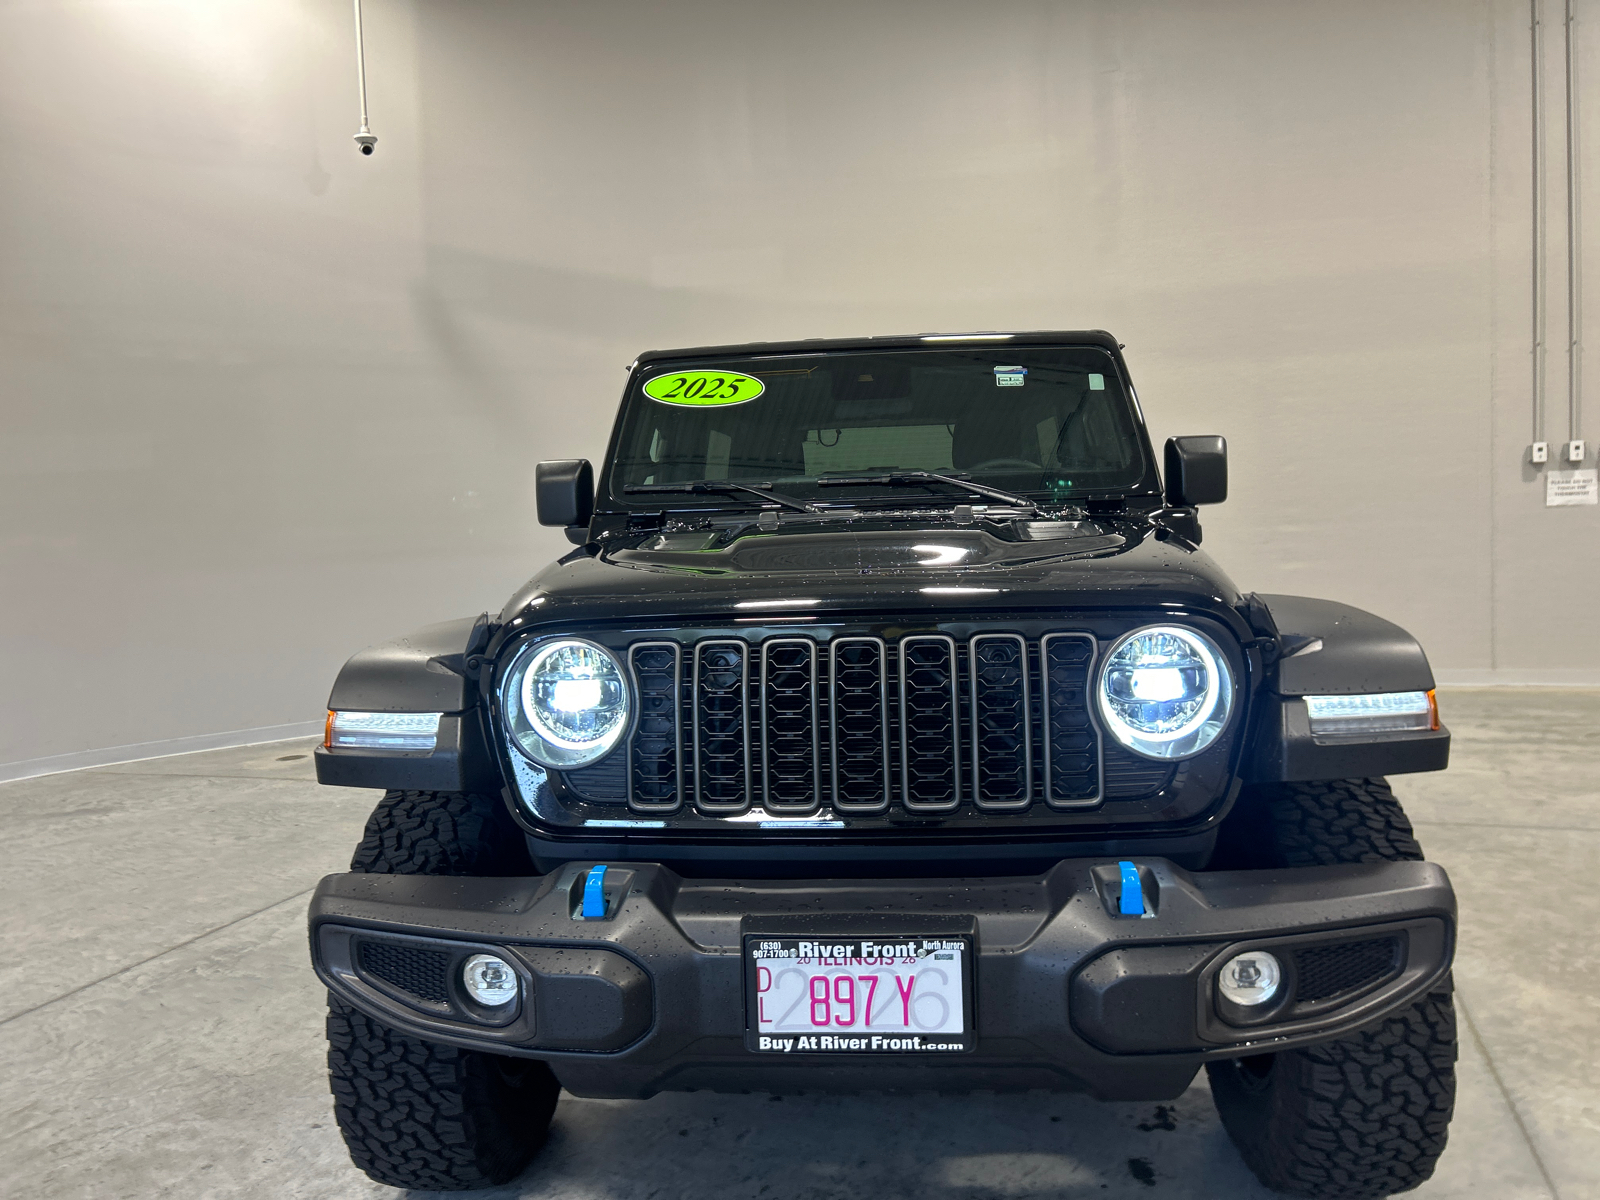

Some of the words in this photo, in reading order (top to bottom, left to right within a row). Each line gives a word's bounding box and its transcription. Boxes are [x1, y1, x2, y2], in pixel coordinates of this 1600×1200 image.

[660, 377, 748, 399] 2025
[760, 941, 781, 950] (630)
[798, 941, 854, 958] River
[861, 941, 917, 958] Front
[922, 940, 941, 950] North
[942, 940, 965, 950] Aurora
[752, 950, 789, 958] 907-1700
[818, 957, 895, 966] ILLINOIS
[895, 975, 915, 1027] Y
[759, 1036, 794, 1052] Buy
[796, 1036, 818, 1050] At
[820, 1036, 869, 1050] River
[871, 1035, 964, 1050] Front.com
